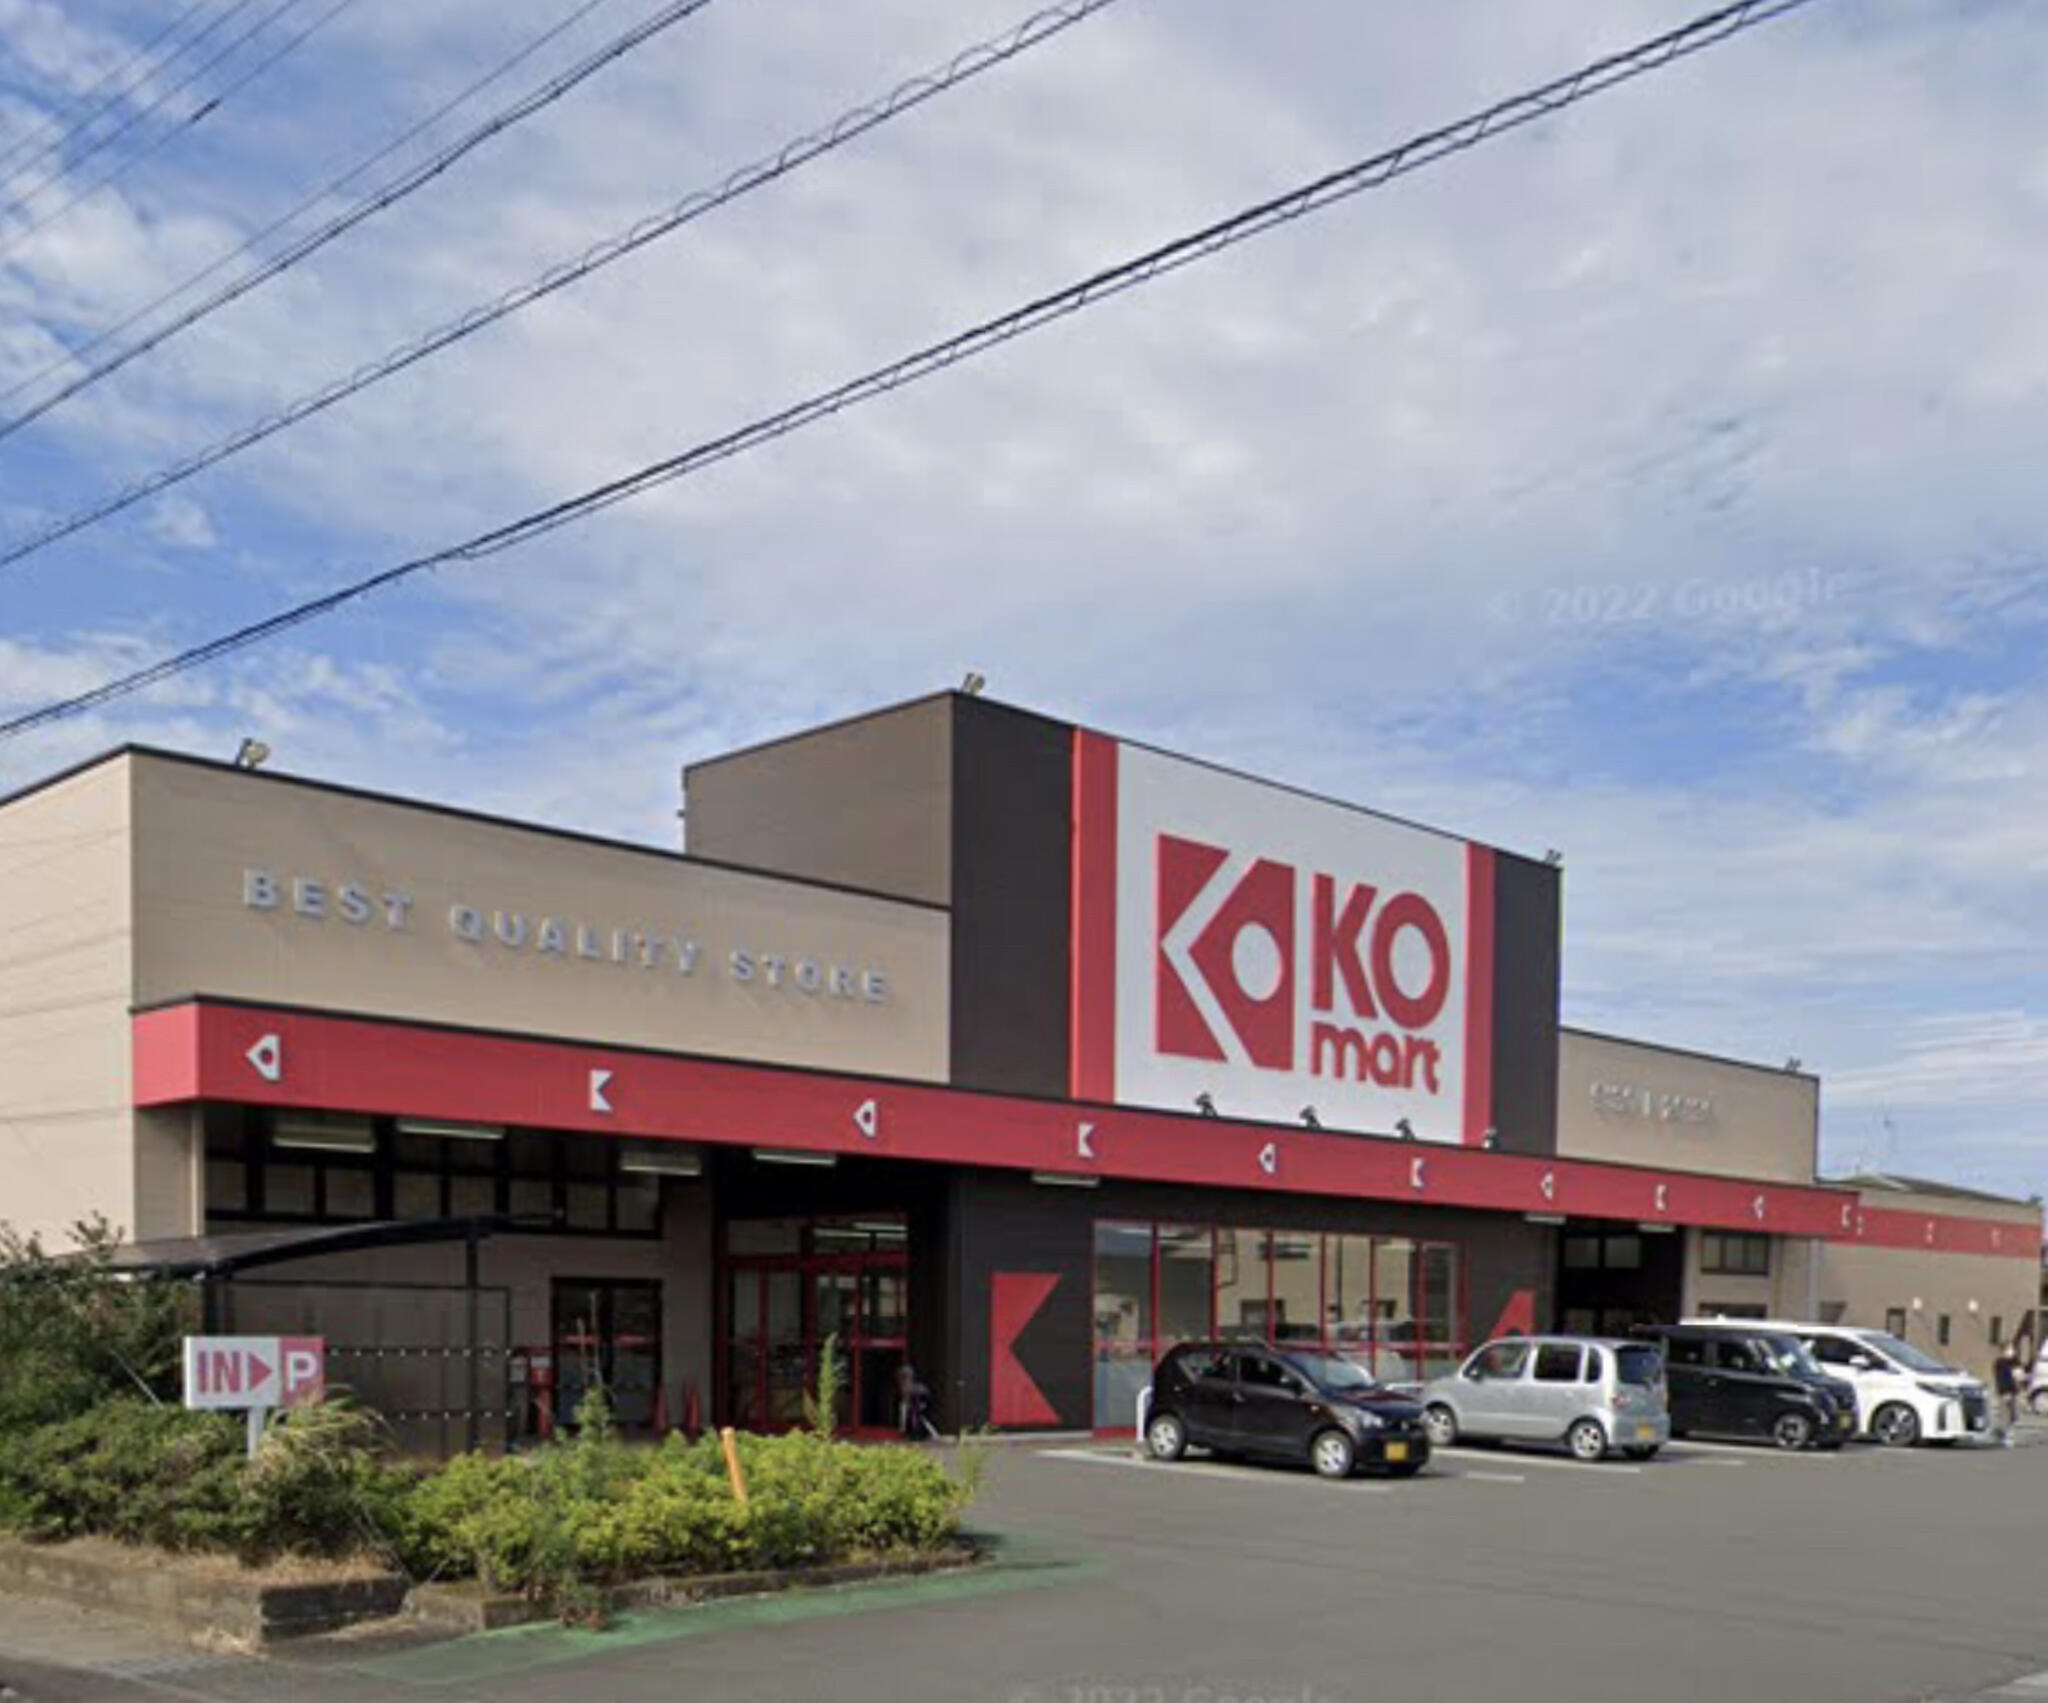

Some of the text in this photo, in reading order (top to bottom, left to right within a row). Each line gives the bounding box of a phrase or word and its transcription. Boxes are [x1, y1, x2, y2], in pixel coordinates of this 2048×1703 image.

[243, 868, 888, 1002] BEST QUALITY STORE
[1311, 872, 1451, 1030] KO
[1310, 1021, 1441, 1096] mart
[197, 1351, 318, 1393] IN P
